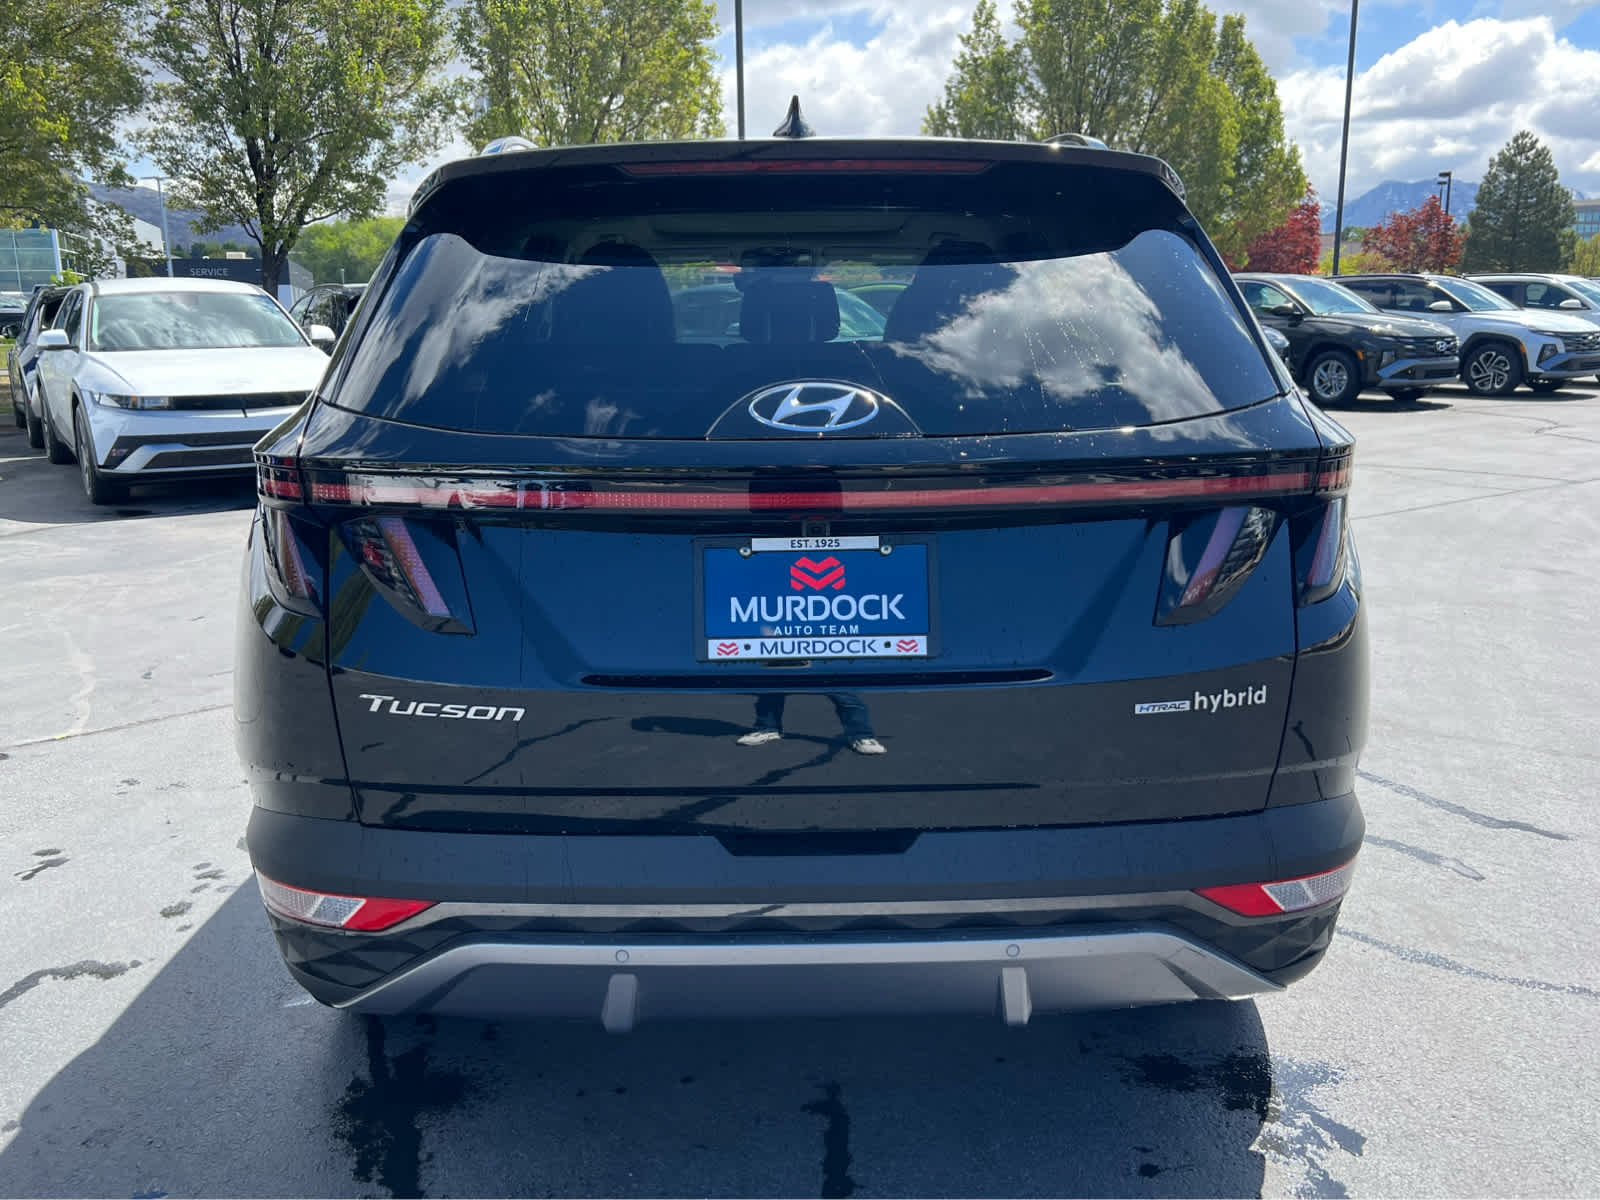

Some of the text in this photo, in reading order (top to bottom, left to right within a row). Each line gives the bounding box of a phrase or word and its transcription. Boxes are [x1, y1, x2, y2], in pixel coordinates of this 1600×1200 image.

[190, 268, 228, 276] SERVICE
[790, 539, 840, 549] EST. 1925
[730, 594, 905, 622] MURDOCK
[774, 625, 859, 636] AUTO TEAM
[760, 639, 877, 655] MURDOCK
[1139, 685, 1267, 713] HTRAC hybrid
